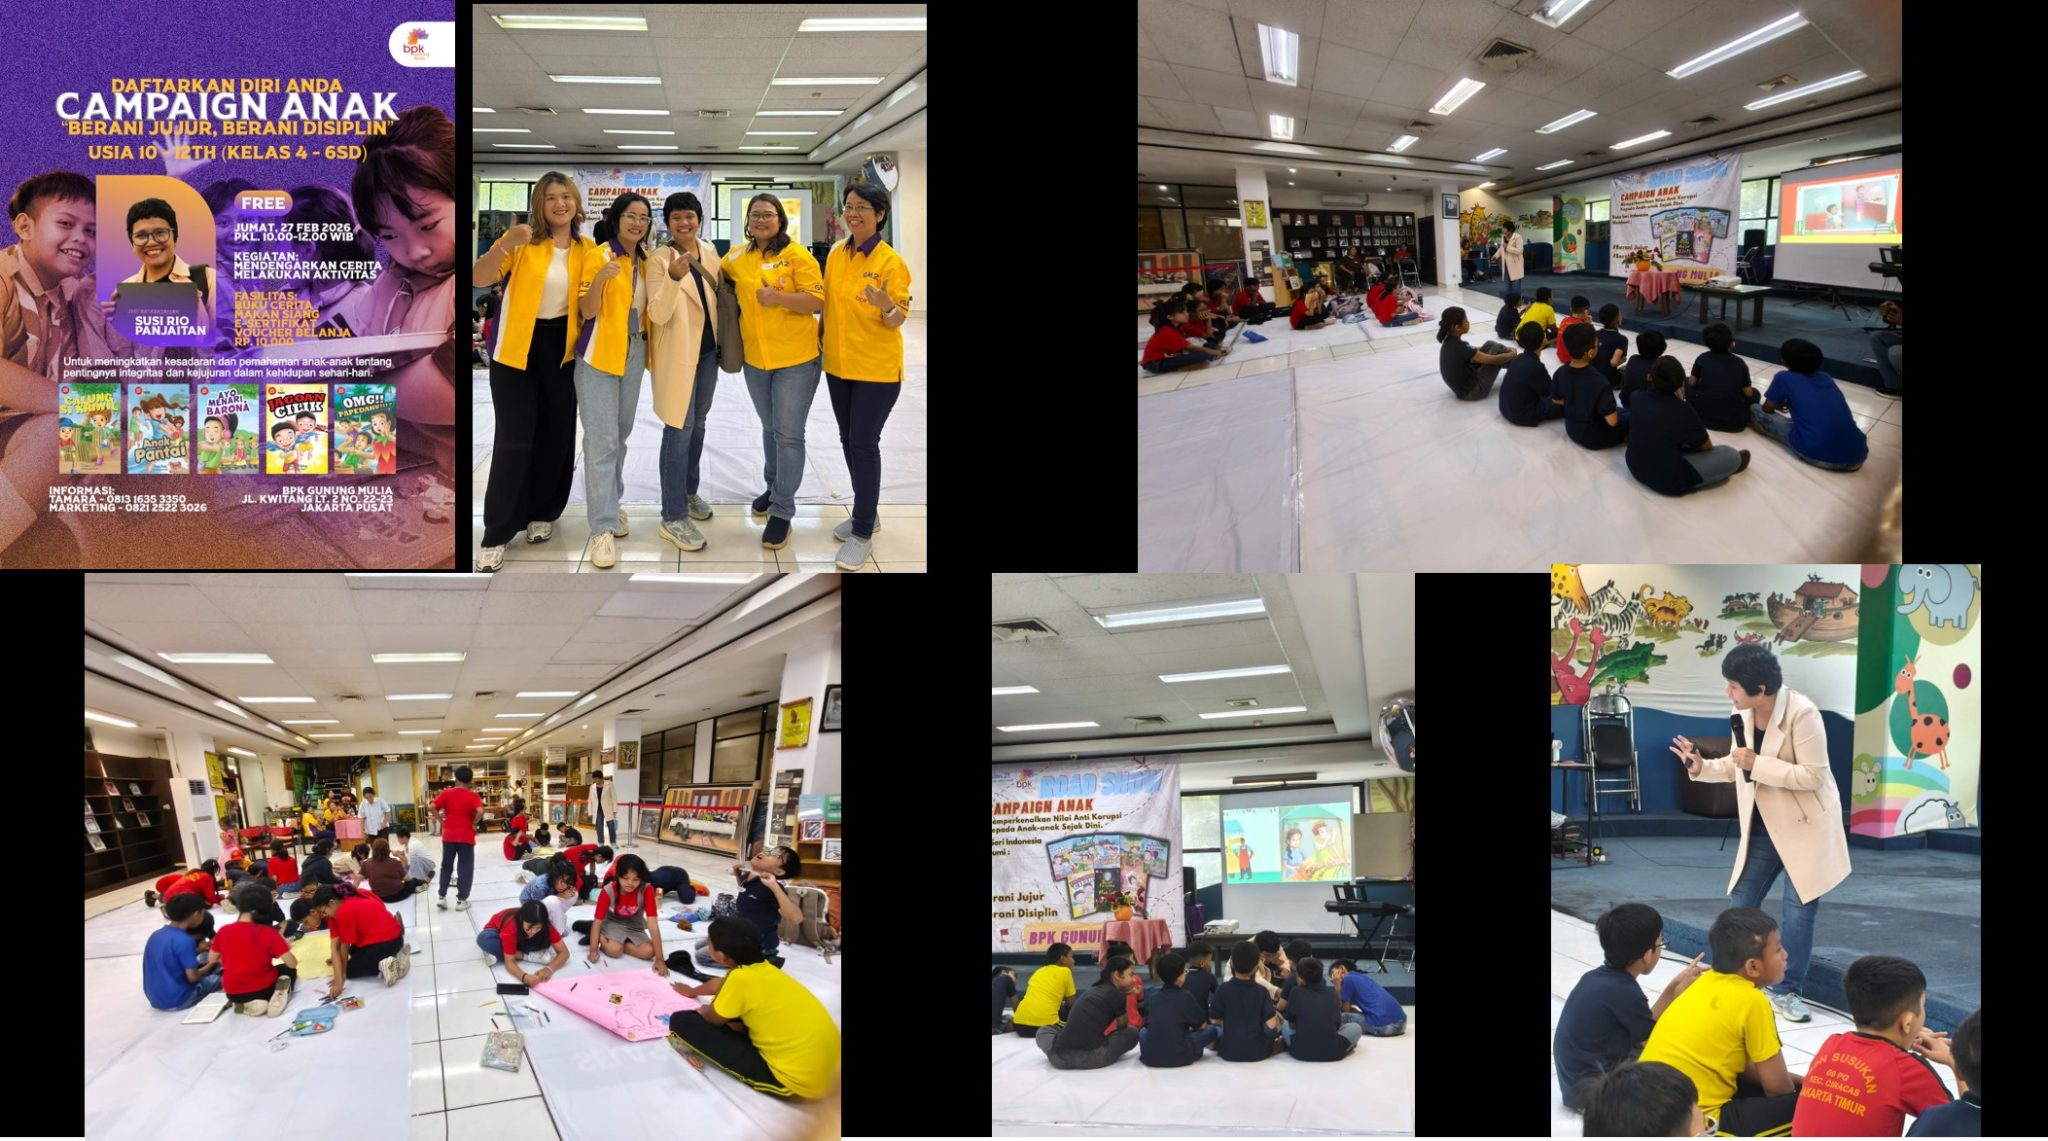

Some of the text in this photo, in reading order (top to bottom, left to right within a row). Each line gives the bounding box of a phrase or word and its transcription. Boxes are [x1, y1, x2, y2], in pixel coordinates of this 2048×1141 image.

[403, 44, 424, 55] bpk
[112, 78, 343, 93] DAFTARKAN DIRI ANDA
[56, 92, 400, 120] CAMPAIGN ANAK
[149, 121, 218, 138] JUJUR,
[222, 121, 298, 135] BERANI
[88, 145, 134, 160] USIA
[139, 145, 158, 160] 10
[174, 145, 216, 160] 12TH
[221, 145, 291, 163] (KELAS
[295, 145, 308, 160] 4
[324, 145, 368, 163] 6SD)
[241, 197, 285, 210] FREE
[234, 223, 351, 234] JUMAT, 27 FEB 2026
[234, 232, 354, 241] PKL. 10.00-12.00 WIB
[234, 252, 299, 261] KEGIATAN:
[234, 261, 383, 270] MENDENGARKAN CERITA
[234, 270, 377, 279] MELAKUKAN AKTIVITAS
[234, 291, 298, 300] FASILITAS:
[235, 300, 313, 310] BUKU CERITA
[235, 309, 320, 319] MAKAN SIANG
[135, 316, 190, 326] SUSI RIO
[235, 319, 317, 328] E-SERTIFIKAT
[135, 326, 207, 336] PANJAITAN
[235, 328, 351, 337] VOUCHER BELANJA
[235, 337, 295, 346] RP. 10.000
[63, 357, 392, 369] Untuk meningkatkan kesadaran dan pemahaman anak-anak tentang
[63, 368, 373, 379] pentingnya integritas dan kejujuran dalam kehidupan sehari-hari.
[64, 393, 113, 406] CALUNG
[218, 389, 236, 399] AYO
[267, 393, 326, 412] JAGOAN
[342, 394, 384, 408] OMG!!
[206, 403, 250, 416] BARONA
[274, 402, 323, 418] CILIK
[143, 437, 170, 448] Anak
[135, 442, 188, 464] Pantai
[49, 486, 115, 495] INFORMASI:
[282, 486, 393, 495] BPK GUNUNG MULIA
[49, 495, 97, 504] TAMARA
[106, 495, 131, 504] 0813
[133, 495, 156, 504] 1635
[159, 495, 186, 504] 3350
[242, 495, 393, 504] JL. KWITANG LT. 2 NO. 22-23
[49, 503, 116, 512] MARKETING
[125, 503, 150, 512] 0821
[152, 503, 178, 512] 2522
[180, 503, 207, 512] 3026
[301, 503, 393, 512] JAKARTA PUSAT
[1040, 769, 1163, 798] ROAD SHOW
[992, 798, 1094, 815] AMPAIGN ANAK
[992, 812, 1123, 825] emperkenalkan Nilai Anti Korupsi
[992, 821, 1103, 834] epada Anak-anak Sejak Dini.
[1006, 837, 1042, 846] Indonesia
[993, 892, 1045, 904] rani Jujur
[993, 908, 1058, 919] rani Disiplin
[1029, 930, 1102, 945] BPK GUNU
[1831, 1052, 1878, 1093] SUSUKAN
[1825, 1080, 1860, 1097] CIRACAS
[1800, 1087, 1866, 1117] AKARTA TIMUR
